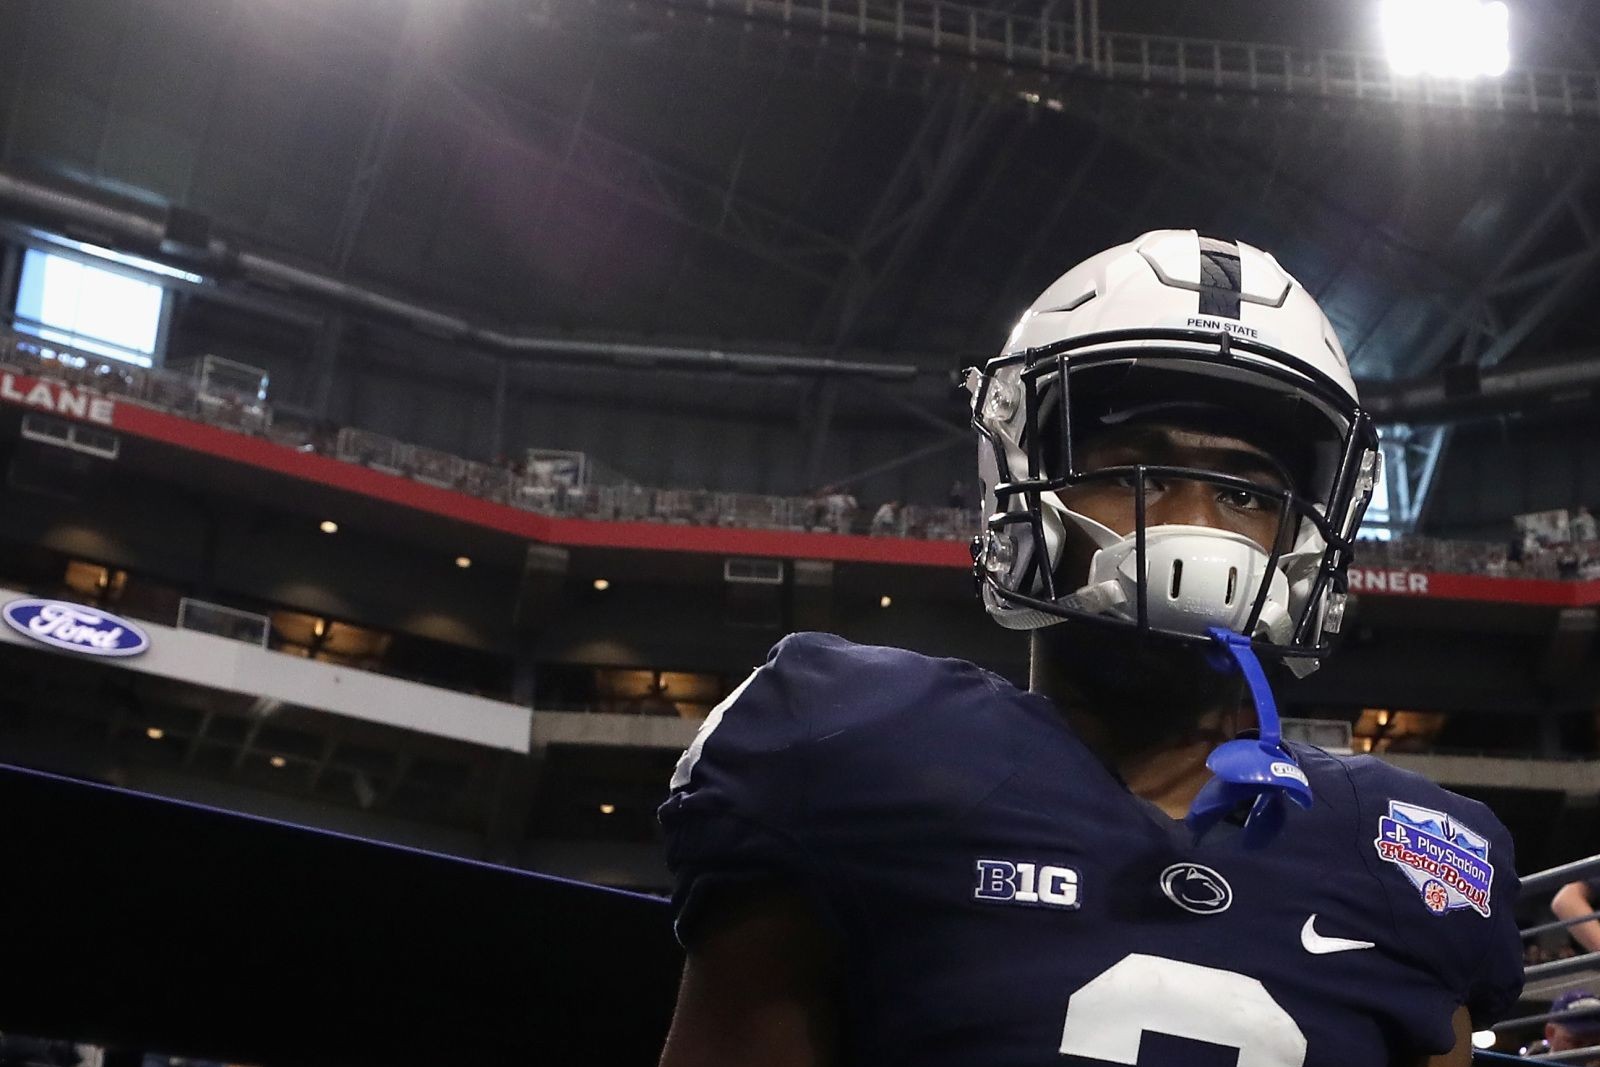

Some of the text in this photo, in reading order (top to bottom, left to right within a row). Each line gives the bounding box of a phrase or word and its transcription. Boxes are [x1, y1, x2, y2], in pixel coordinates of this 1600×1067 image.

[1187, 318, 1258, 338] PENN STATE
[2, 374, 113, 424] LANE
[1347, 569, 1428, 593] RNER
[29, 604, 124, 649] Ford
[1380, 841, 1488, 909] Fiesta Bowl
[1417, 836, 1487, 881] PlayStation
